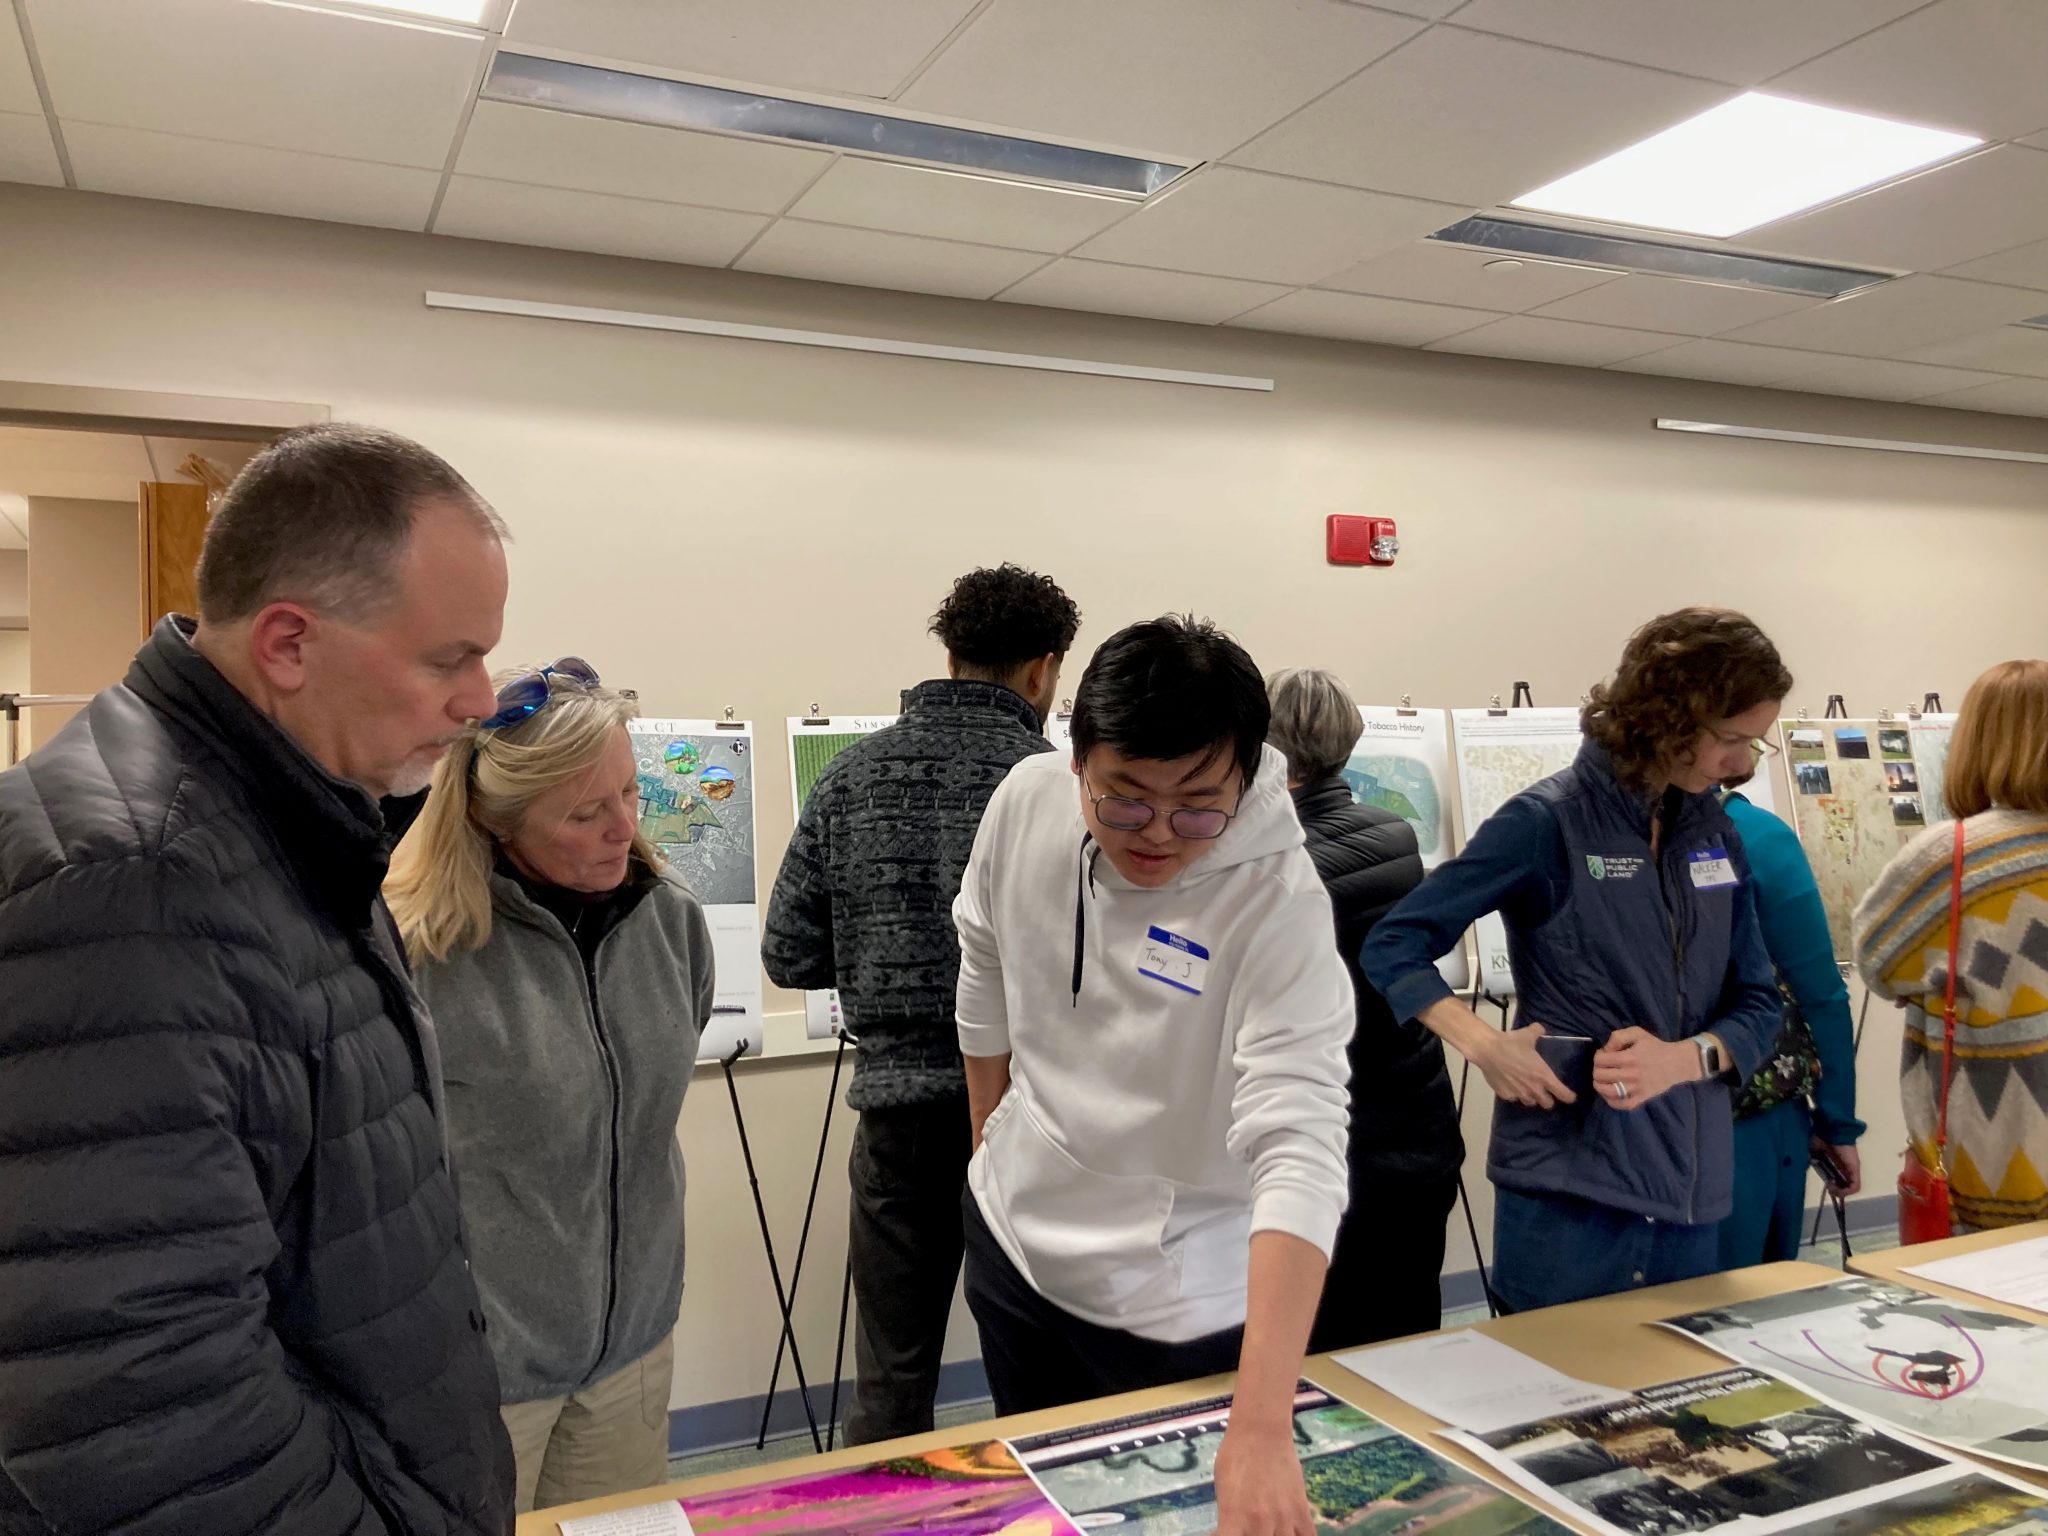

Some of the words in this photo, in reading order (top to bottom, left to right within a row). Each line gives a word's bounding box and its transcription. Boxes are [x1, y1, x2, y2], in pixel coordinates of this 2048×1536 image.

[655, 722, 678, 733] CT
[1367, 721, 1398, 731] Tobacco
[1399, 723, 1425, 733] History
[1146, 947, 1168, 972] Tony
[1181, 962, 1193, 978] J
